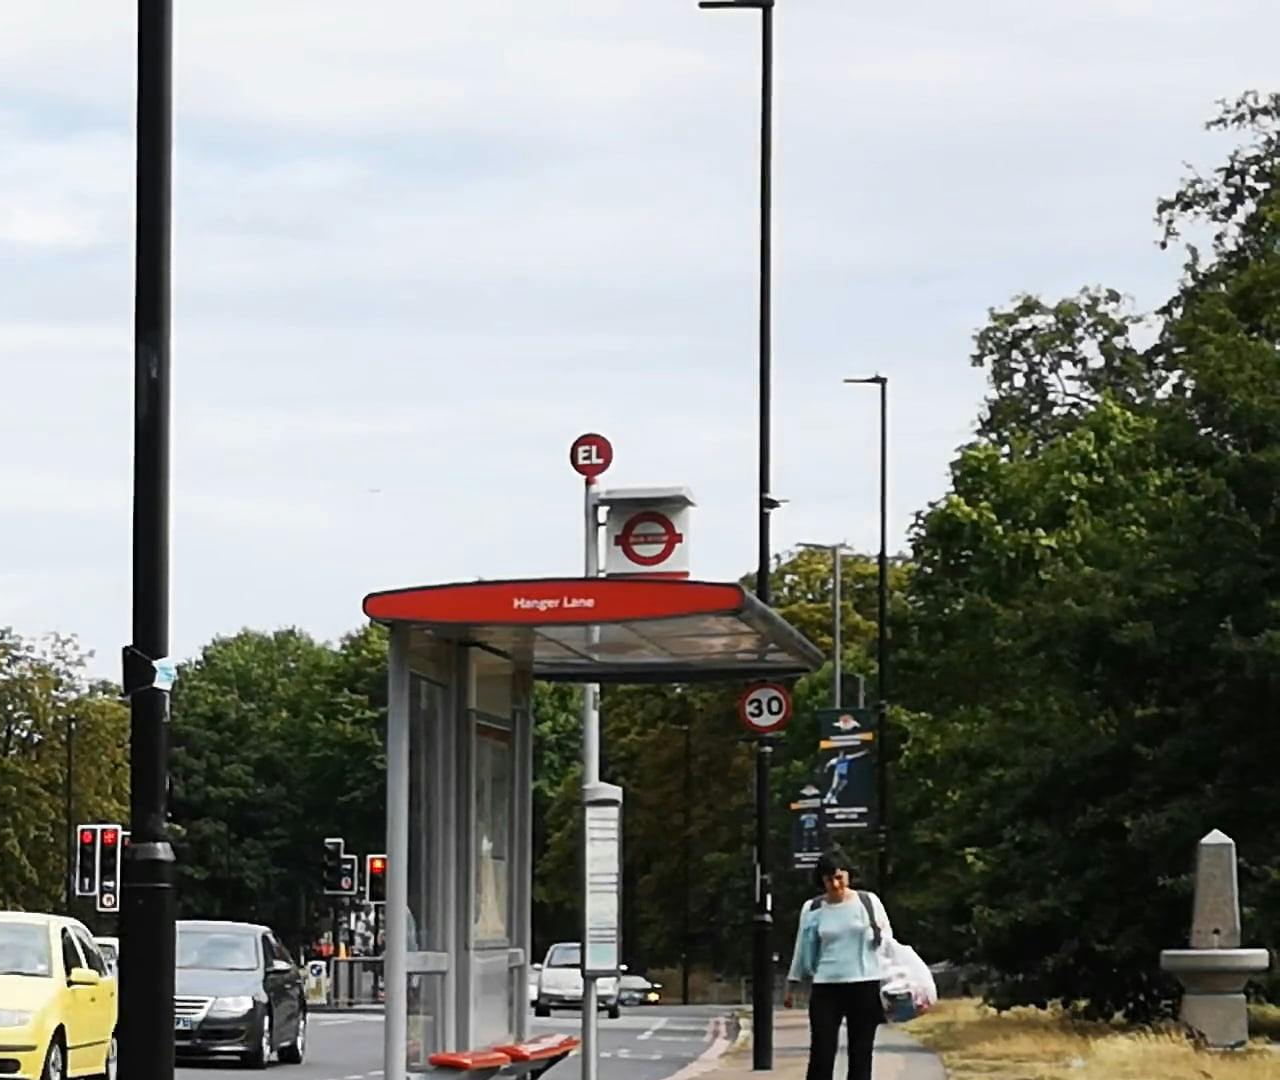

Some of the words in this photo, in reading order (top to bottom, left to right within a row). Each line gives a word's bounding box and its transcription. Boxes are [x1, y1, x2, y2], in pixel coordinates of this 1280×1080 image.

[578, 445, 604, 464] EL
[513, 597, 560, 611] Hanger
[563, 596, 595, 608] Lane
[748, 696, 783, 718] 30
